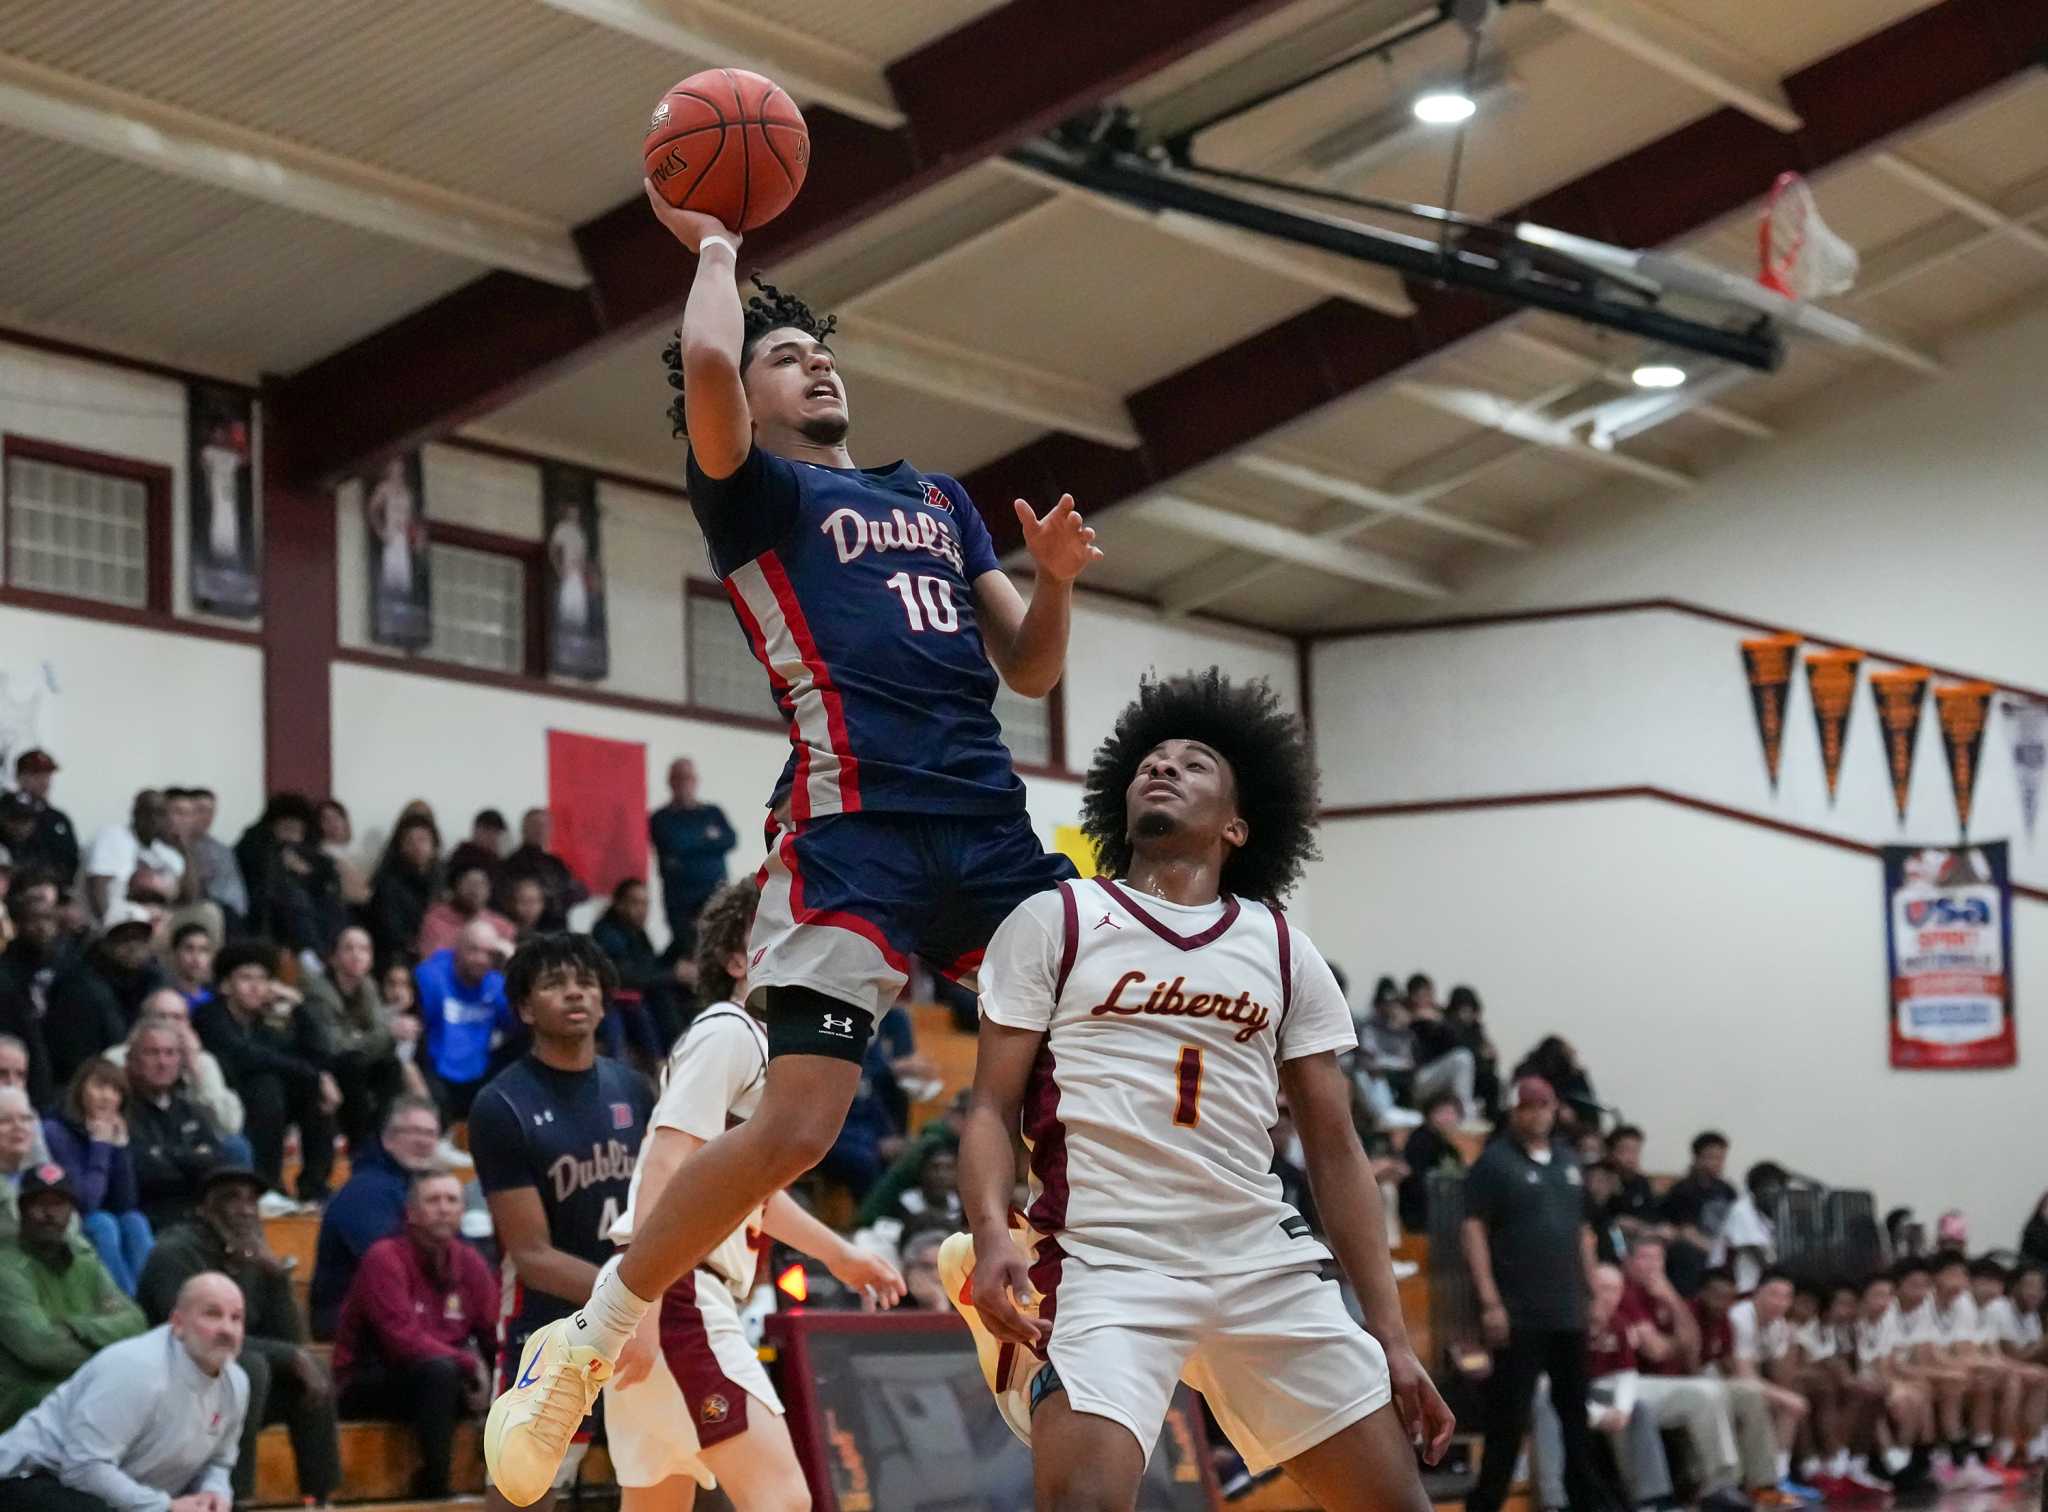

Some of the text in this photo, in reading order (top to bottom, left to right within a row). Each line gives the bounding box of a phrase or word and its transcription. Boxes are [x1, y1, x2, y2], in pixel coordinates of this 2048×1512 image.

[886, 572, 959, 633] 10
[1091, 970, 1270, 1043] Liberty
[1172, 1043, 1205, 1129] 1
